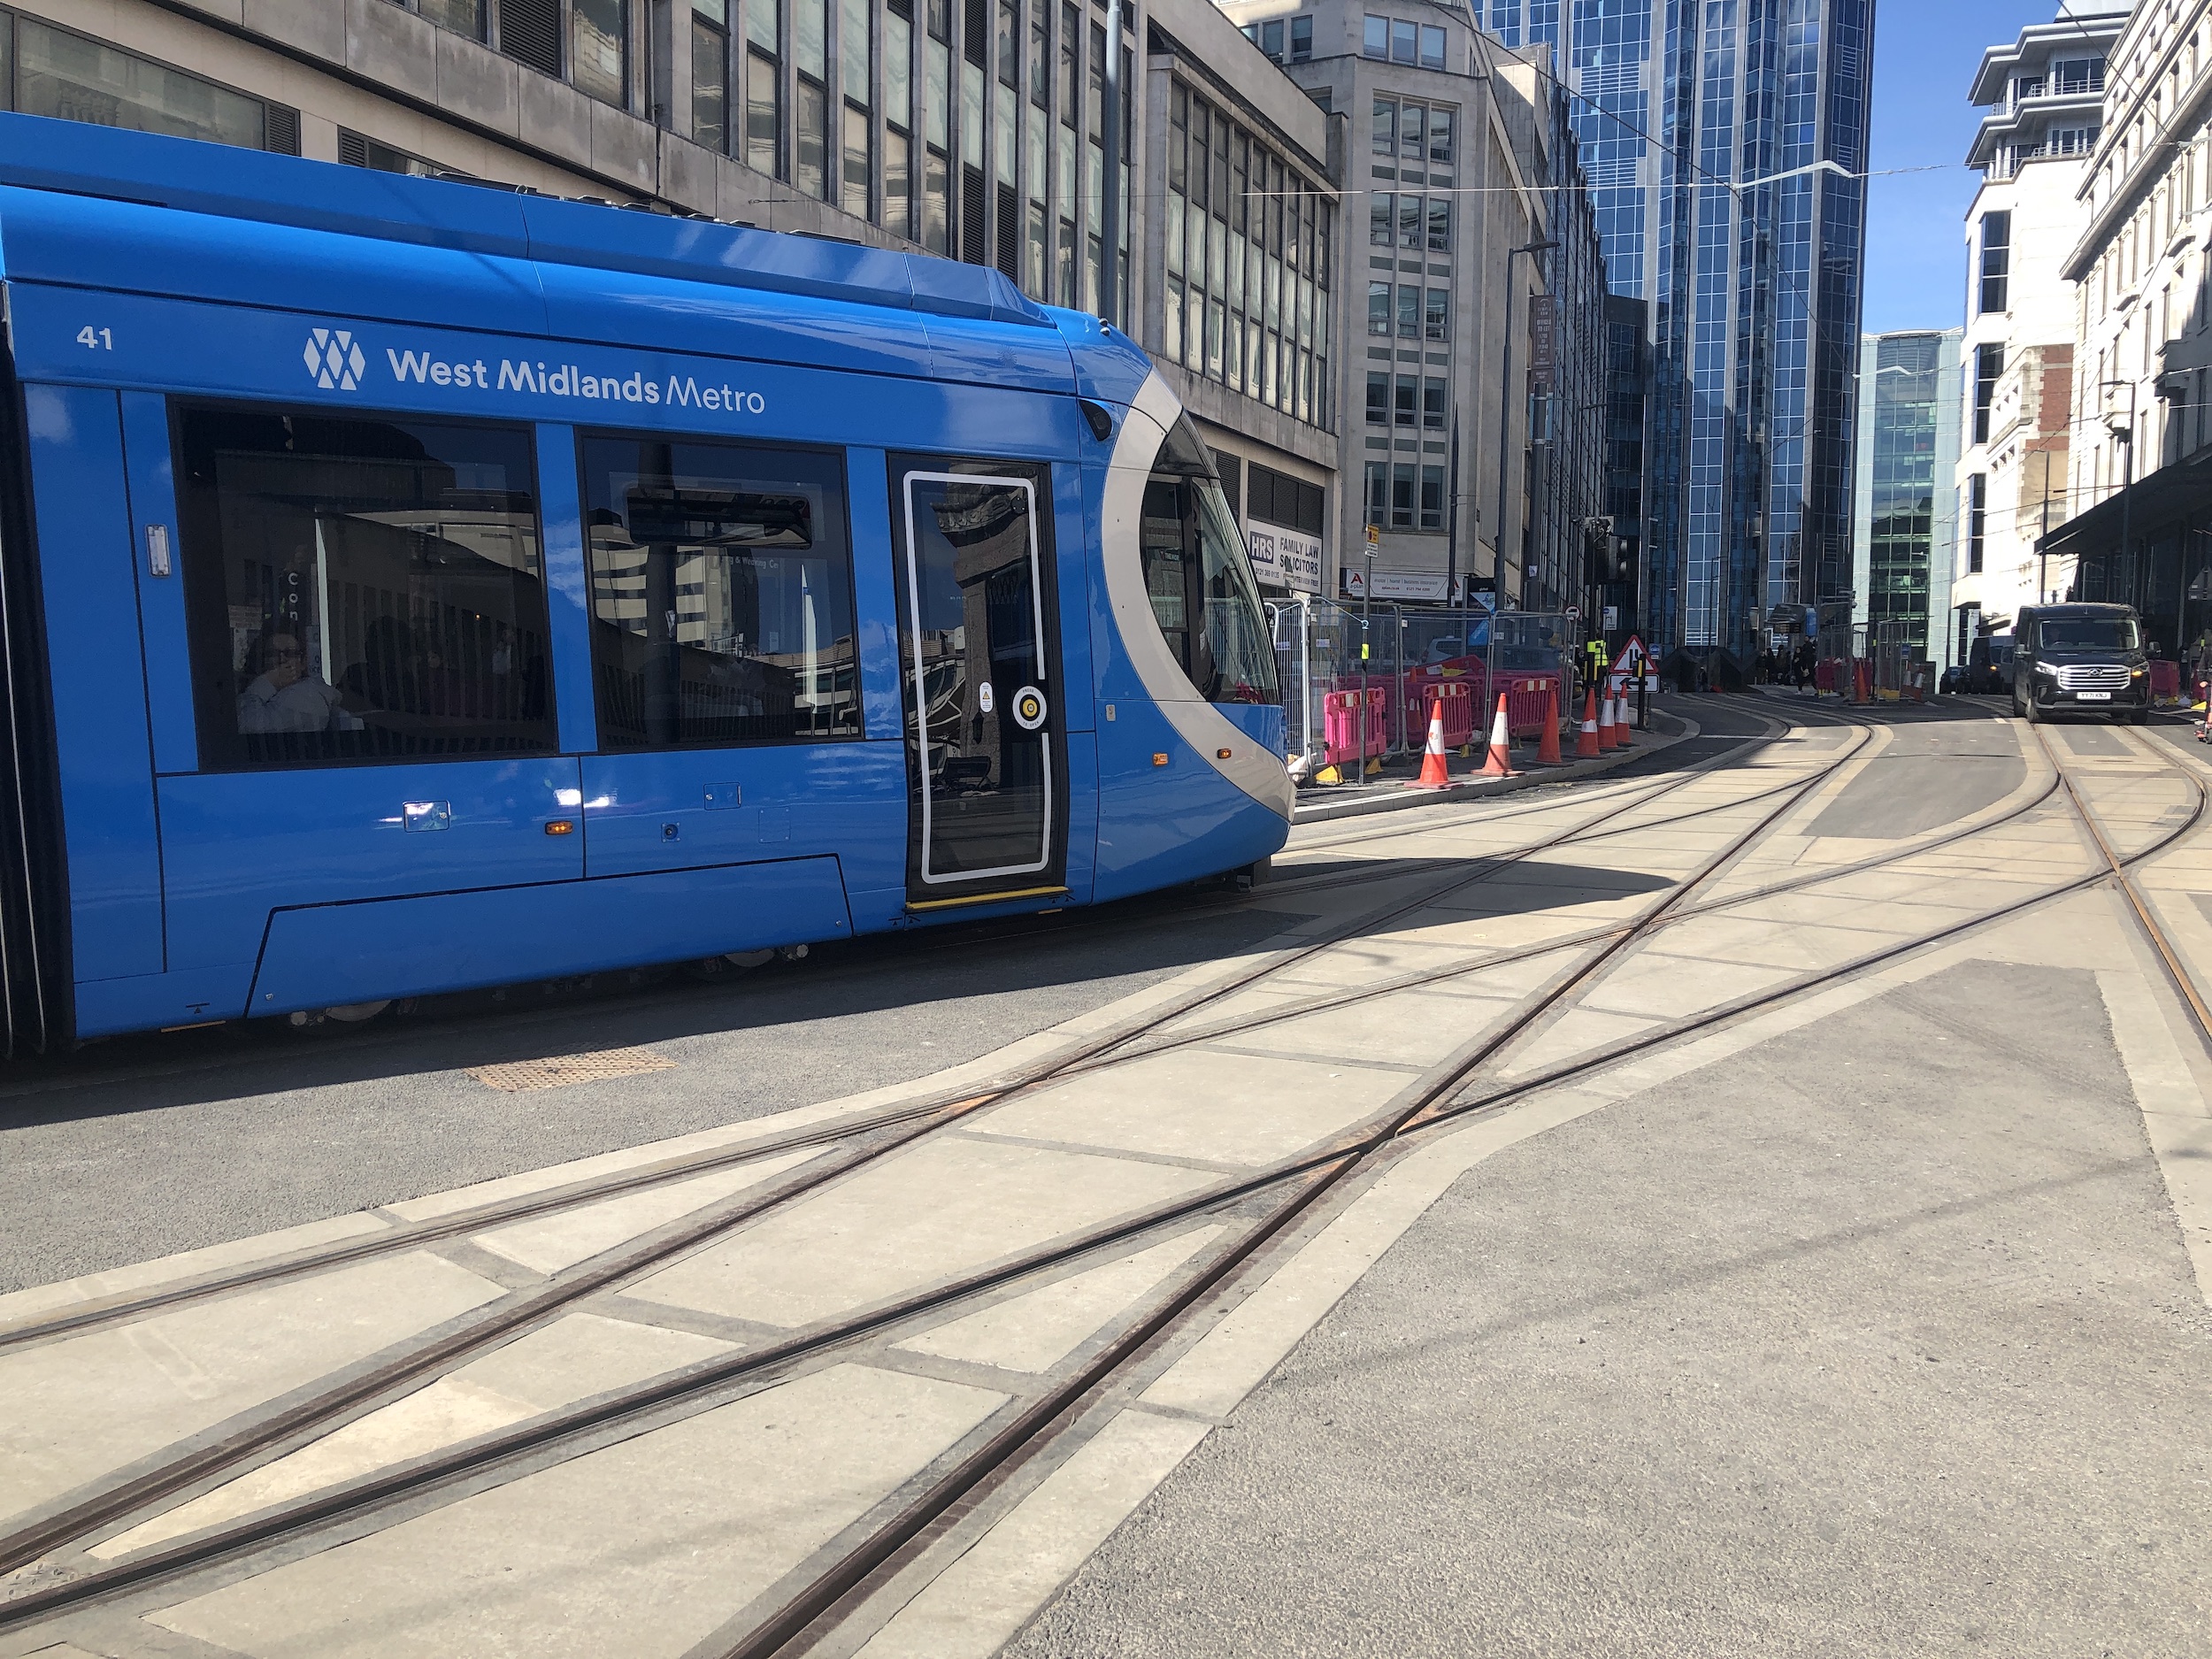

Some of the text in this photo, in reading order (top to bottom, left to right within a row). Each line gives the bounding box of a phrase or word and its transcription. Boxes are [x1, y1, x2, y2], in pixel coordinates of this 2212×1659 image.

[76, 326, 112, 350] 41
[386, 348, 766, 414] West Midlands Metro
[1251, 535, 1273, 560] HRS
[1279, 537, 1319, 559] FAMILY LAW
[1294, 575, 1310, 585] NTERVIEW
